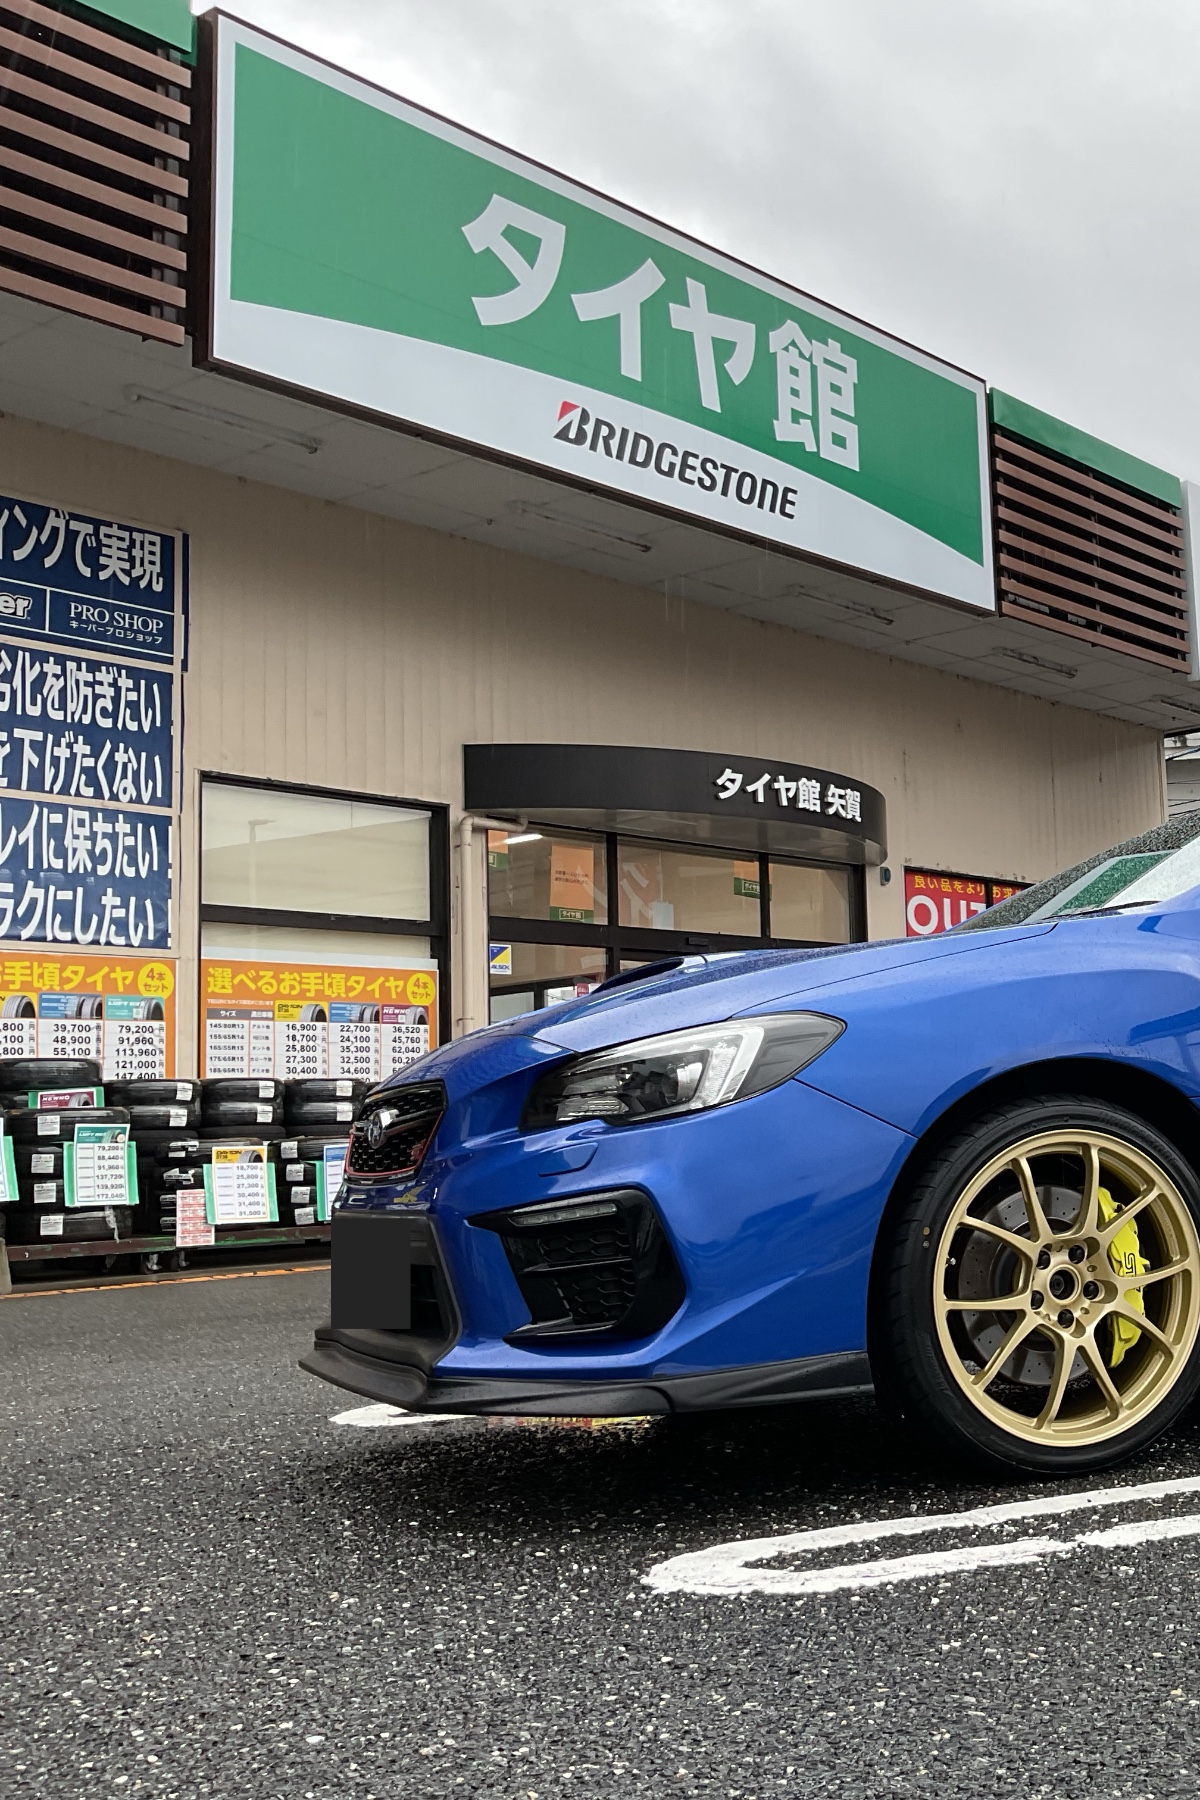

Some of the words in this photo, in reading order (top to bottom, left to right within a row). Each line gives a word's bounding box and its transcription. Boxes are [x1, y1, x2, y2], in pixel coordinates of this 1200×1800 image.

[460, 193, 861, 472] タイヤ館
[553, 400, 799, 520] BRIDGESTONE
[69, 602, 110, 624] PRO
[113, 611, 164, 634] SHOP
[712, 767, 822, 813] タイヤ館
[824, 783, 862, 823] 矢賀
[0, 961, 134, 993] 手頃タイヤ
[146, 967, 166, 981] 4本
[143, 982, 168, 993] セット
[207, 967, 405, 999] 選べるお手頃タイヤ
[413, 977, 429, 990] 4本
[411, 991, 431, 999] セット
[53, 1023, 91, 1034] 39,700
[118, 1025, 154, 1035] 79,200
[285, 1024, 317, 1032] 16,900
[340, 1025, 371, 1033] 22,700
[392, 1026, 421, 1034] 36,520
[53, 1035, 91, 1046] 48,900
[118, 1036, 154, 1047] 91,960
[285, 1034, 317, 1043] 18,700
[340, 1035, 371, 1044] 24,100
[392, 1037, 421, 1045] 45,760
[53, 1048, 91, 1058] 55,100
[115, 1048, 157, 1059] 113,960
[285, 1045, 317, 1053] 25,800
[340, 1046, 371, 1054] 35,300
[392, 1047, 421, 1055] 62,040
[285, 1056, 317, 1064] 27,300
[340, 1056, 371, 1065] 32,500
[114, 1060, 157, 1071] 121,000
[285, 1066, 317, 1075] 30,400
[114, 1072, 157, 1080] 147400
[340, 1067, 371, 1075] 34,600
